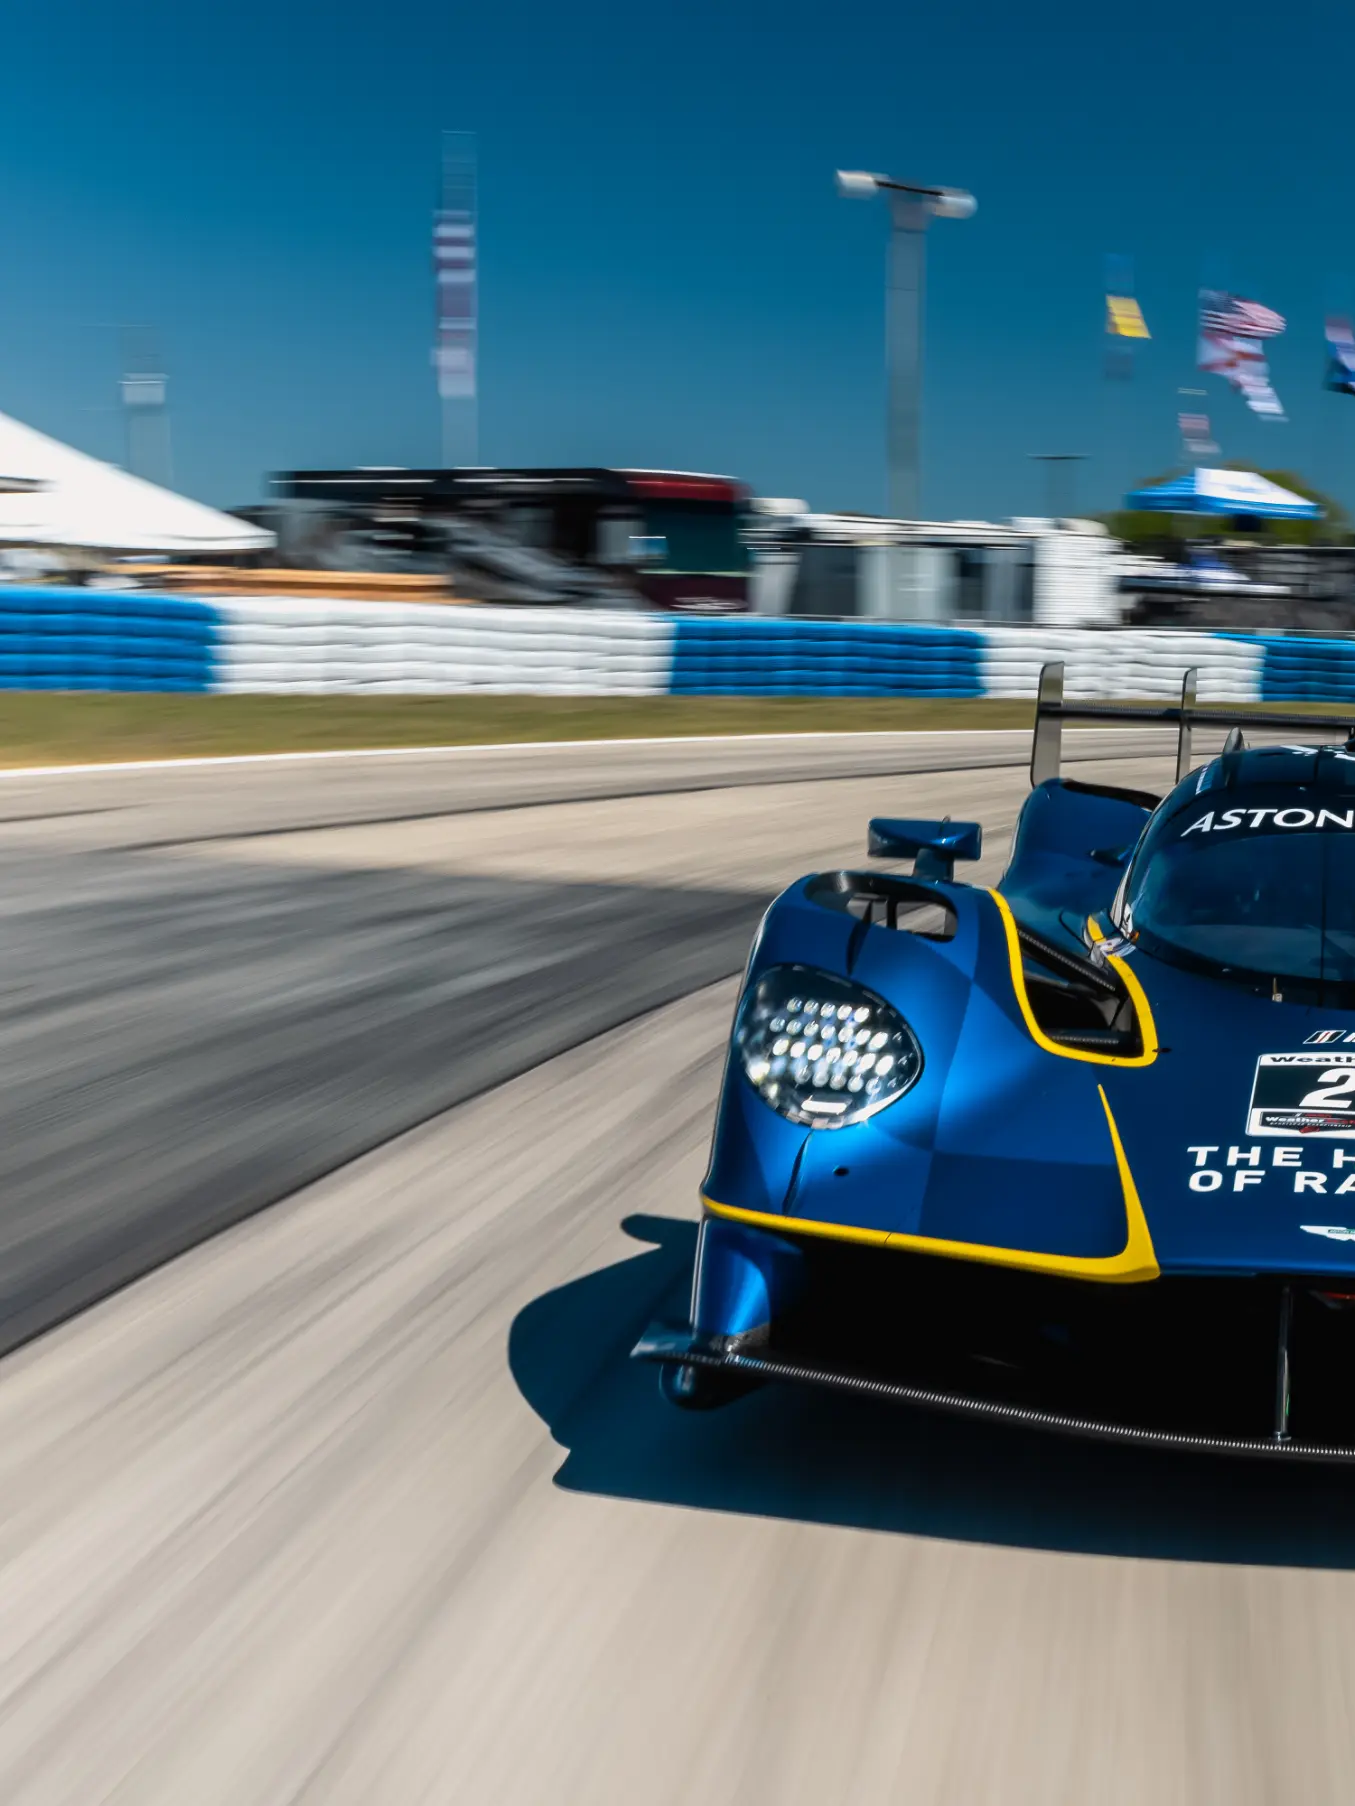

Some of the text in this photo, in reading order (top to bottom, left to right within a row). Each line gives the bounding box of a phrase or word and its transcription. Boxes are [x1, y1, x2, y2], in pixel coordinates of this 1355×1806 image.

[1180, 808, 1354, 838] ASTON
[1187, 1146, 1304, 1167] THE
[1188, 1170, 1266, 1193] OF
